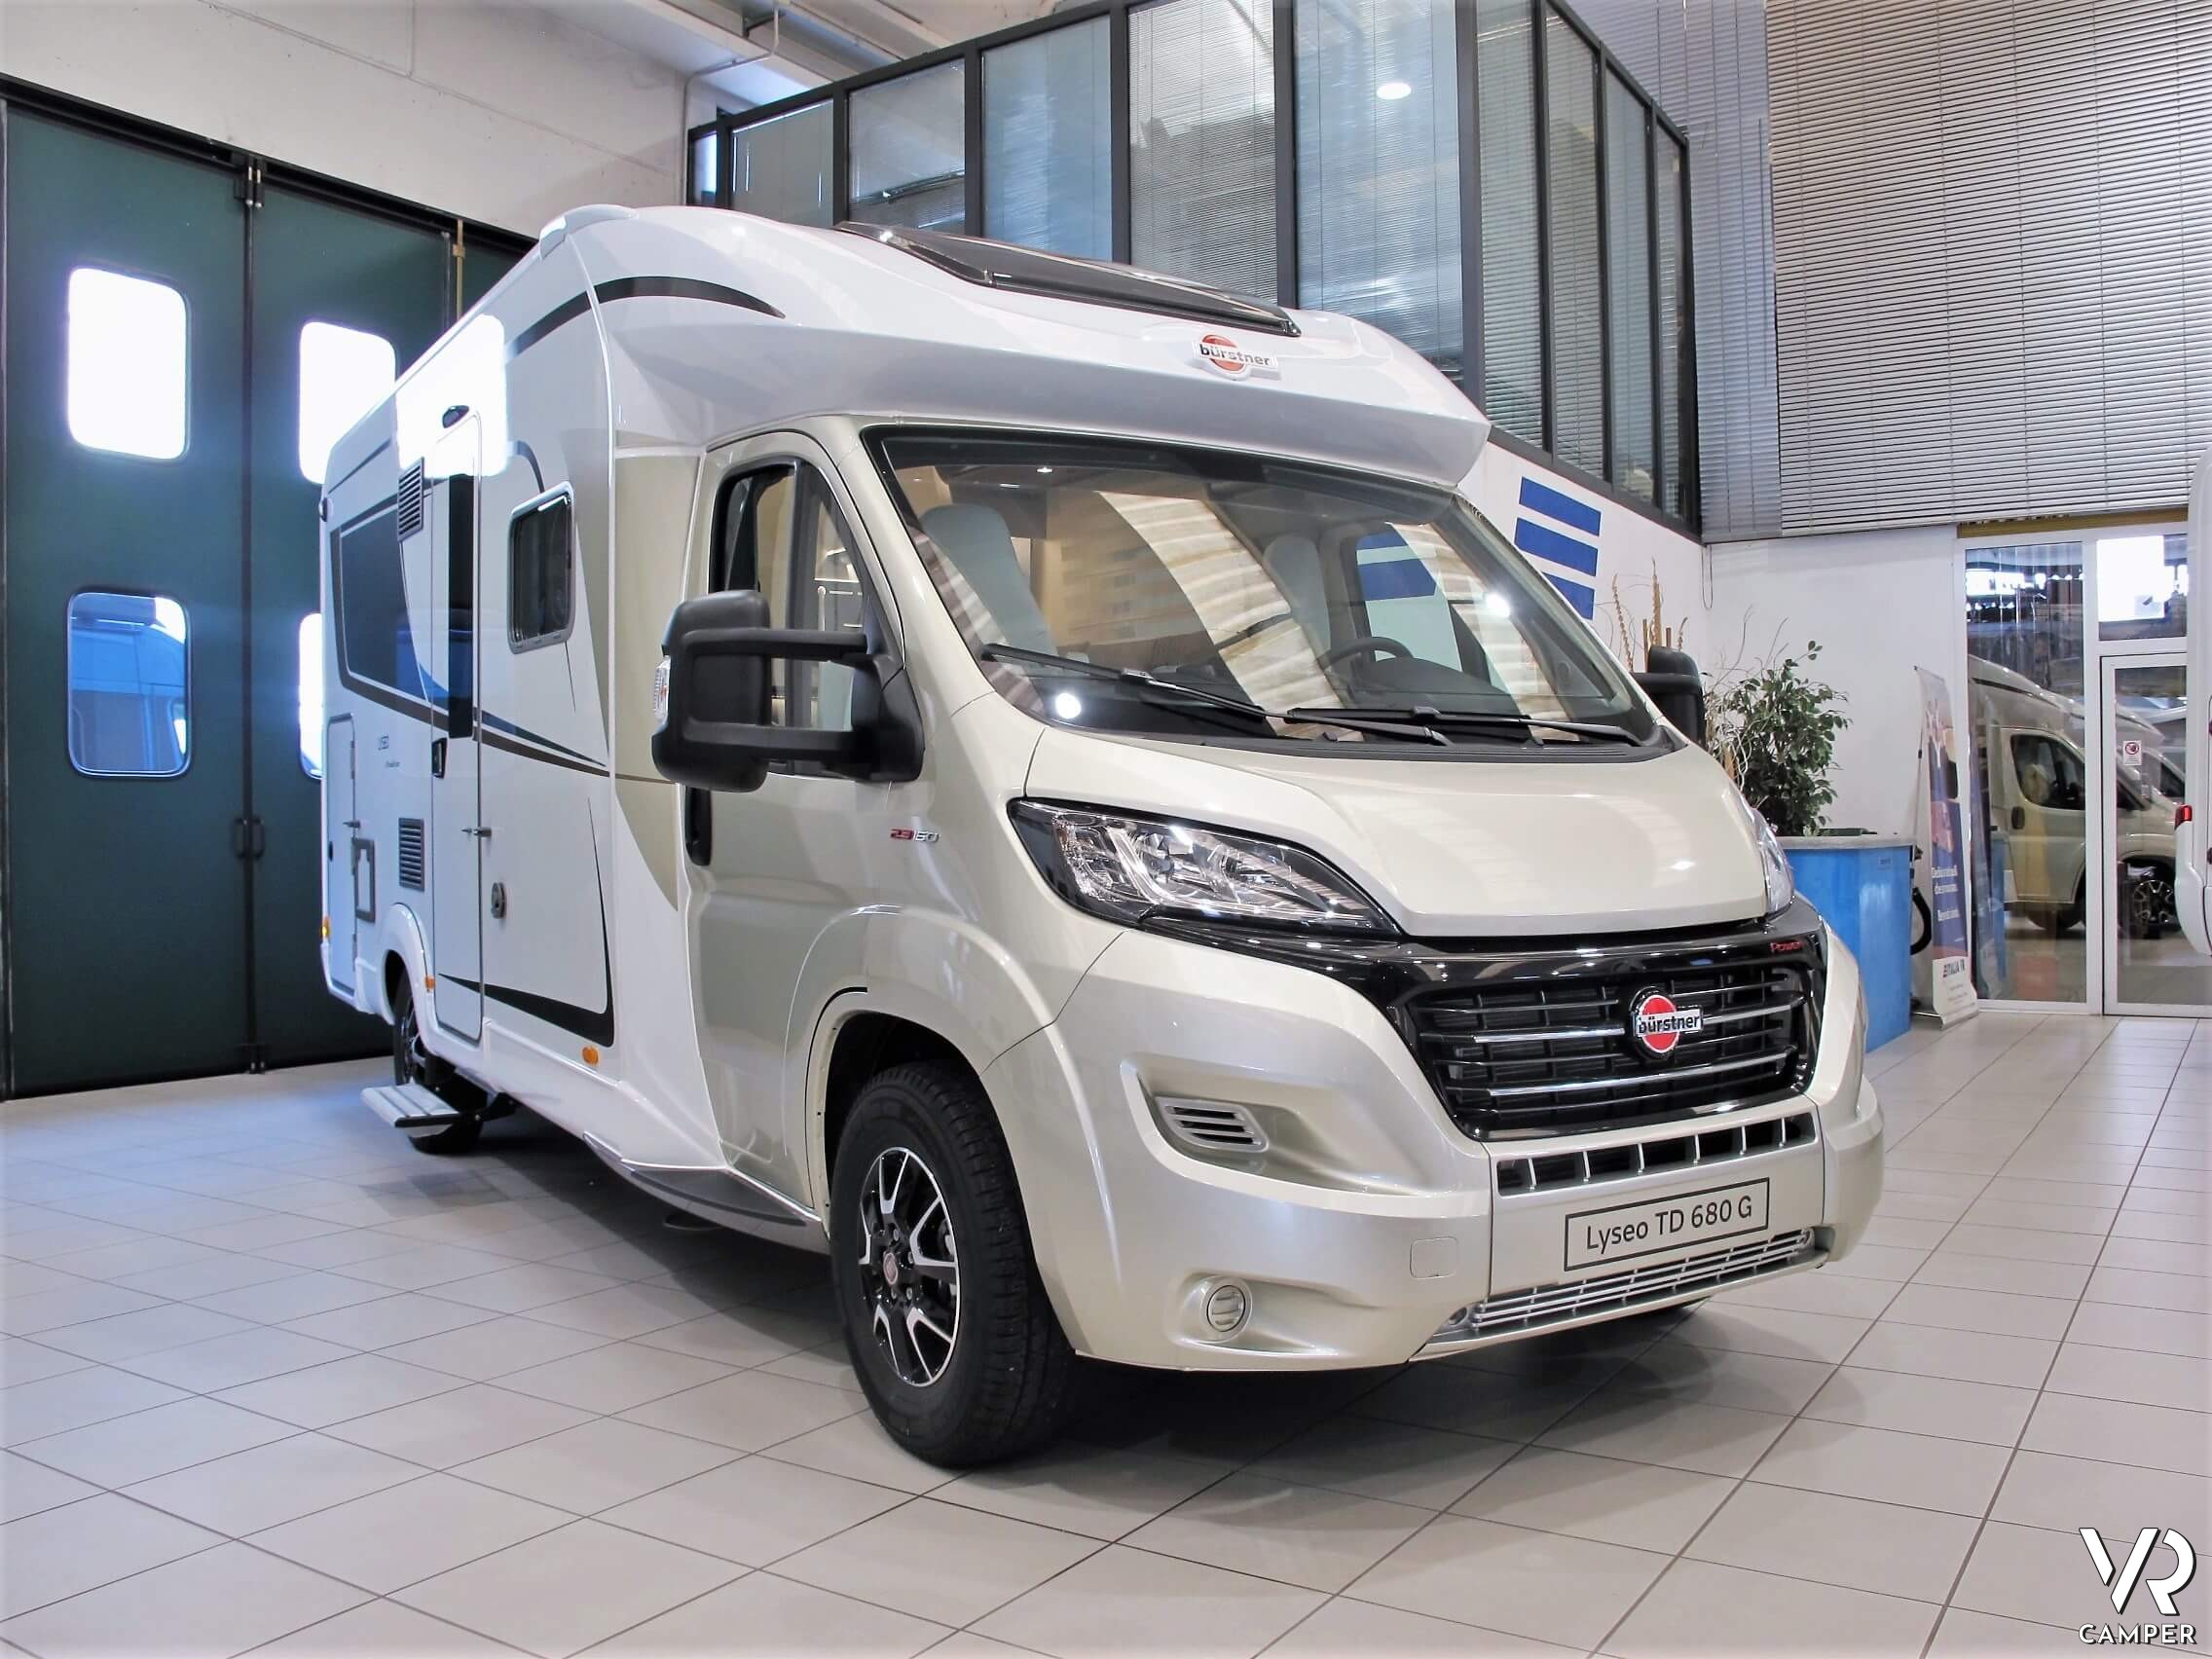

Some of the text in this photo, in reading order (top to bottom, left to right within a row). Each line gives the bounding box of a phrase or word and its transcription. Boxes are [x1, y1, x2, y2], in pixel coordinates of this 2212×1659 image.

[1198, 343, 1271, 366] bürstner
[1639, 1014, 1700, 1034] bürstner
[1586, 1195, 1752, 1255] Lyseo TD 680 G
